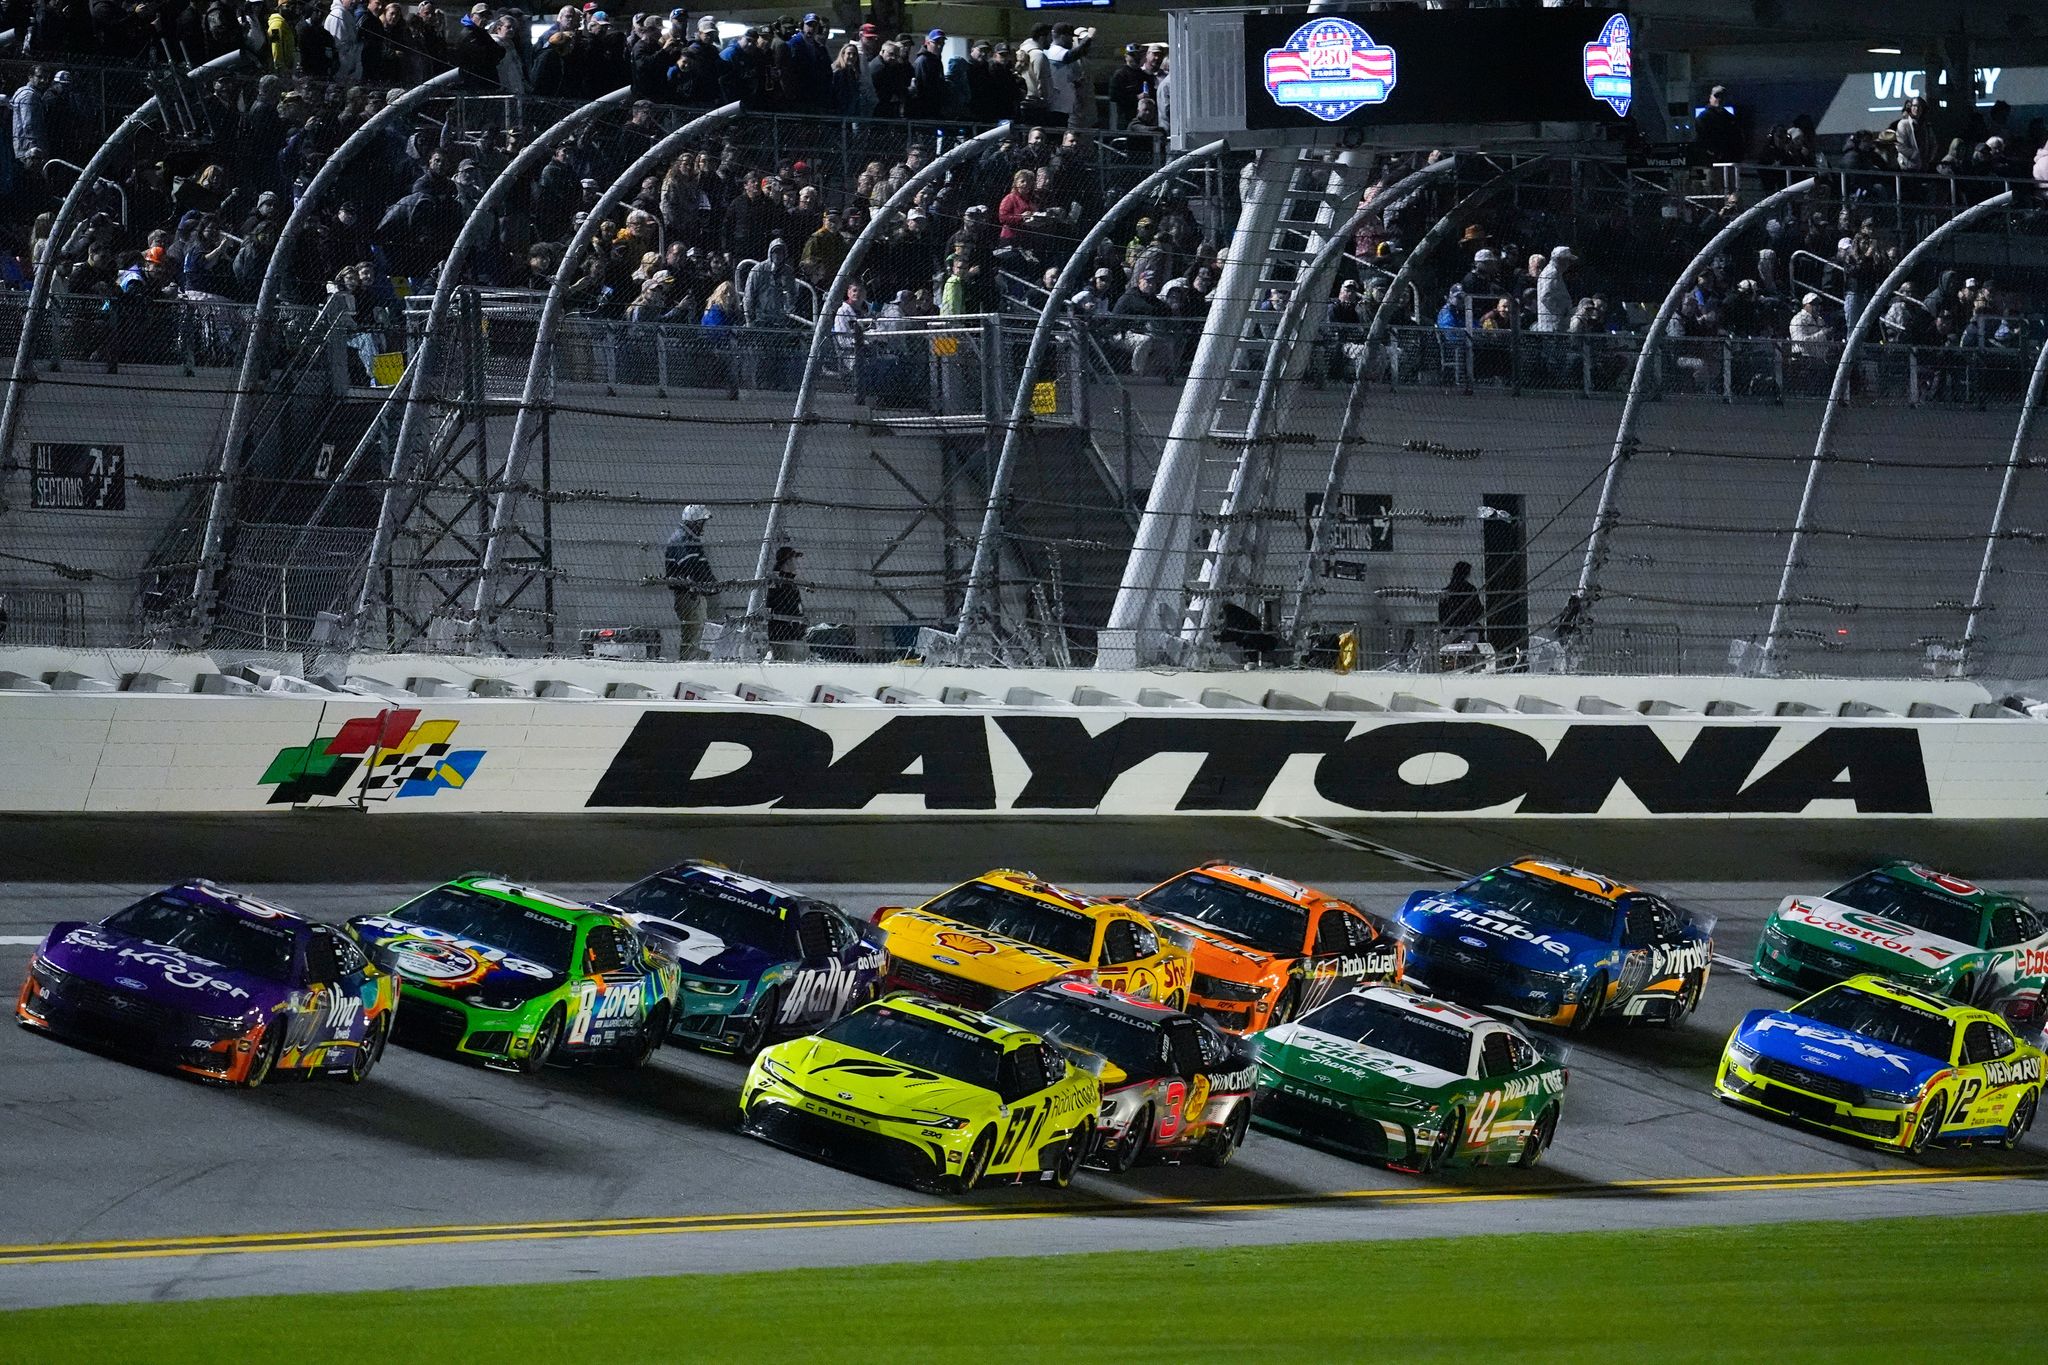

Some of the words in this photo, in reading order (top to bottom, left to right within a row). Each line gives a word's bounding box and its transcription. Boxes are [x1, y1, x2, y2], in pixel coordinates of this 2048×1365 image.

[1311, 48, 1349, 66] 250
[1873, 67, 2001, 100] VICY
[37, 477, 83, 506] SECTIONS
[585, 711, 1932, 815] DAYTONA
[718, 892, 776, 916] BOWMAN
[1036, 901, 1083, 920] LOGANO
[1246, 892, 1306, 916] BUESCHER
[1574, 890, 1613, 908] LAJOIE
[523, 911, 573, 931] BUSCH
[1414, 898, 1571, 958] Trimble
[1804, 915, 1911, 955] Castrol
[117, 948, 250, 999] Kroger
[1340, 953, 1366, 982] Body
[40, 987, 50, 1000] 60
[596, 984, 641, 1019] zone
[780, 969, 816, 1024] 48
[808, 956, 857, 1023] ally
[326, 982, 361, 1028] Viva
[567, 980, 597, 1044] 8
[1900, 1004, 1942, 1020] BLANEY
[1090, 1007, 1105, 1016] A.
[1107, 1012, 1156, 1032] DILLON
[1404, 1014, 1469, 1039] NEMECHEK
[947, 1028, 979, 1043] HEIM
[1754, 1018, 1912, 1075] PEAK
[1298, 1053, 1369, 1080] Sharpie
[1312, 1043, 1388, 1071] TREE
[1730, 1060, 1738, 1072] 12
[1283, 1084, 1348, 1110] CAMRY
[1944, 1078, 1982, 1125] 12
[1984, 1057, 2041, 1087] MENARD
[805, 1103, 871, 1127] CAMRY
[1160, 1082, 1187, 1139] 3
[1467, 1089, 1502, 1144] 42
[1502, 1075, 1539, 1103] DOLLAR
[1540, 1068, 1563, 1094] TREE
[992, 1104, 1037, 1167] 67
[1051, 1078, 1096, 1119] Robinhood
